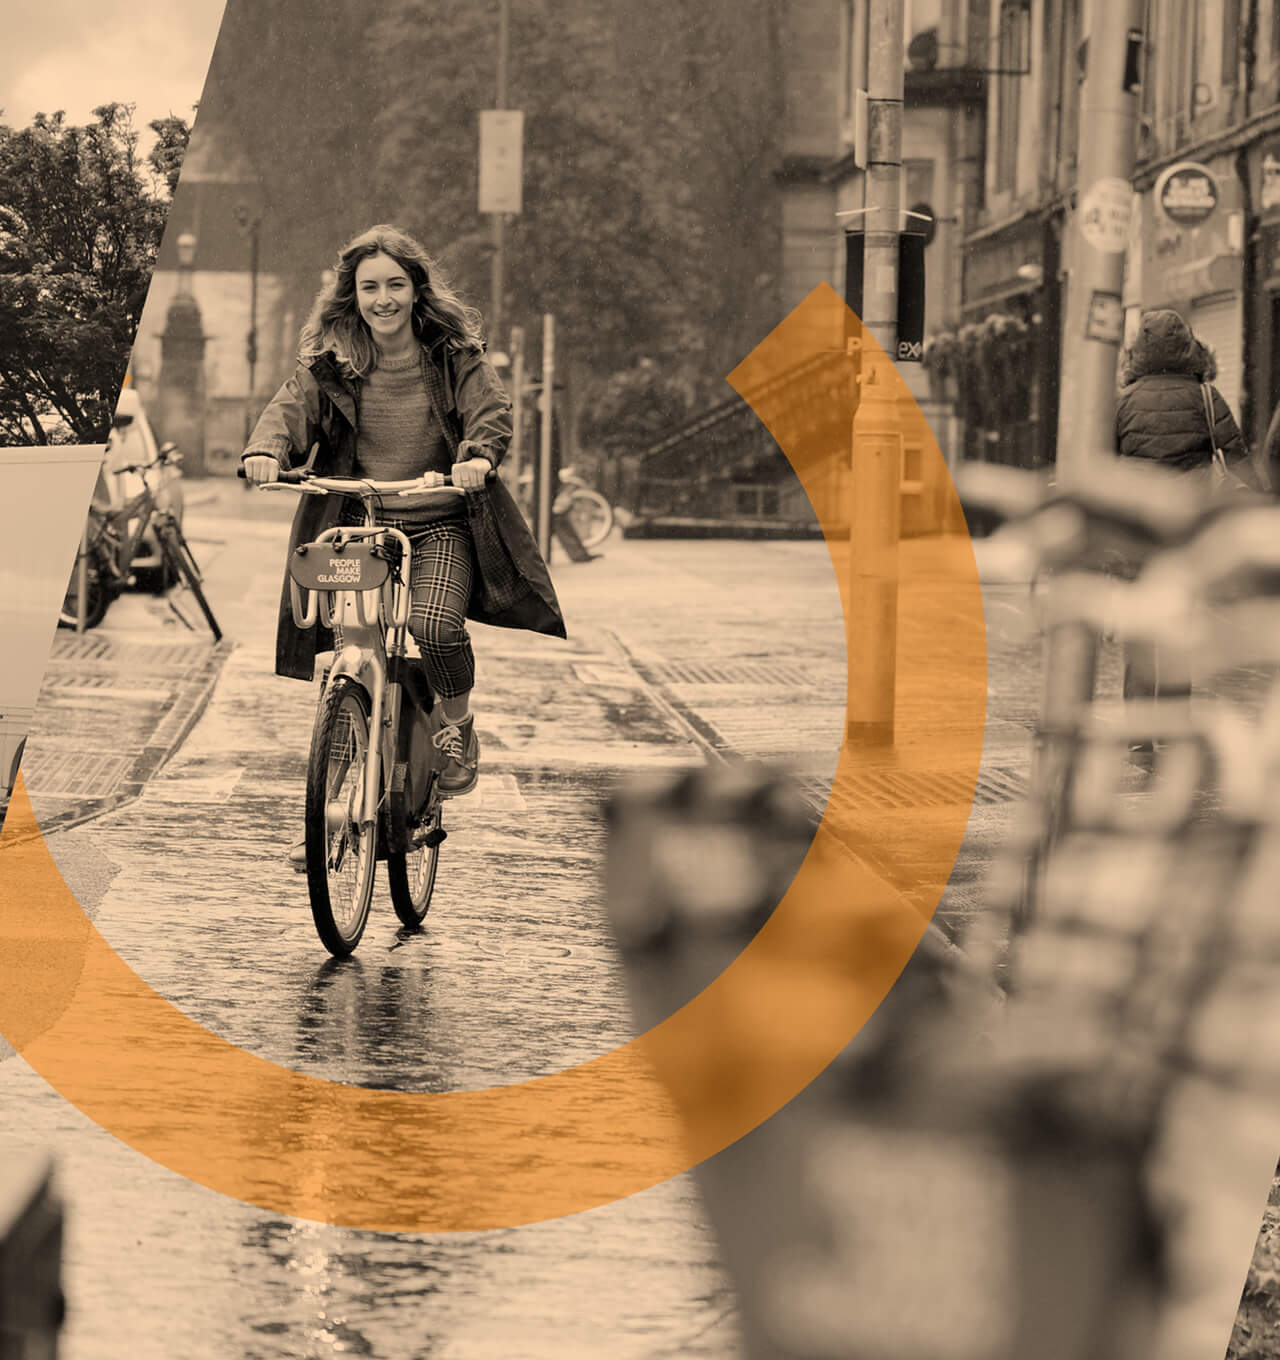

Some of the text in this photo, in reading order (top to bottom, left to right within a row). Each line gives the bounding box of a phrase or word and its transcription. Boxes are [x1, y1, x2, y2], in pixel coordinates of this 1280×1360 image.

[329, 559, 361, 567] PEOPLE
[336, 567, 361, 575] MAKE
[318, 574, 361, 583] GLASGOW
